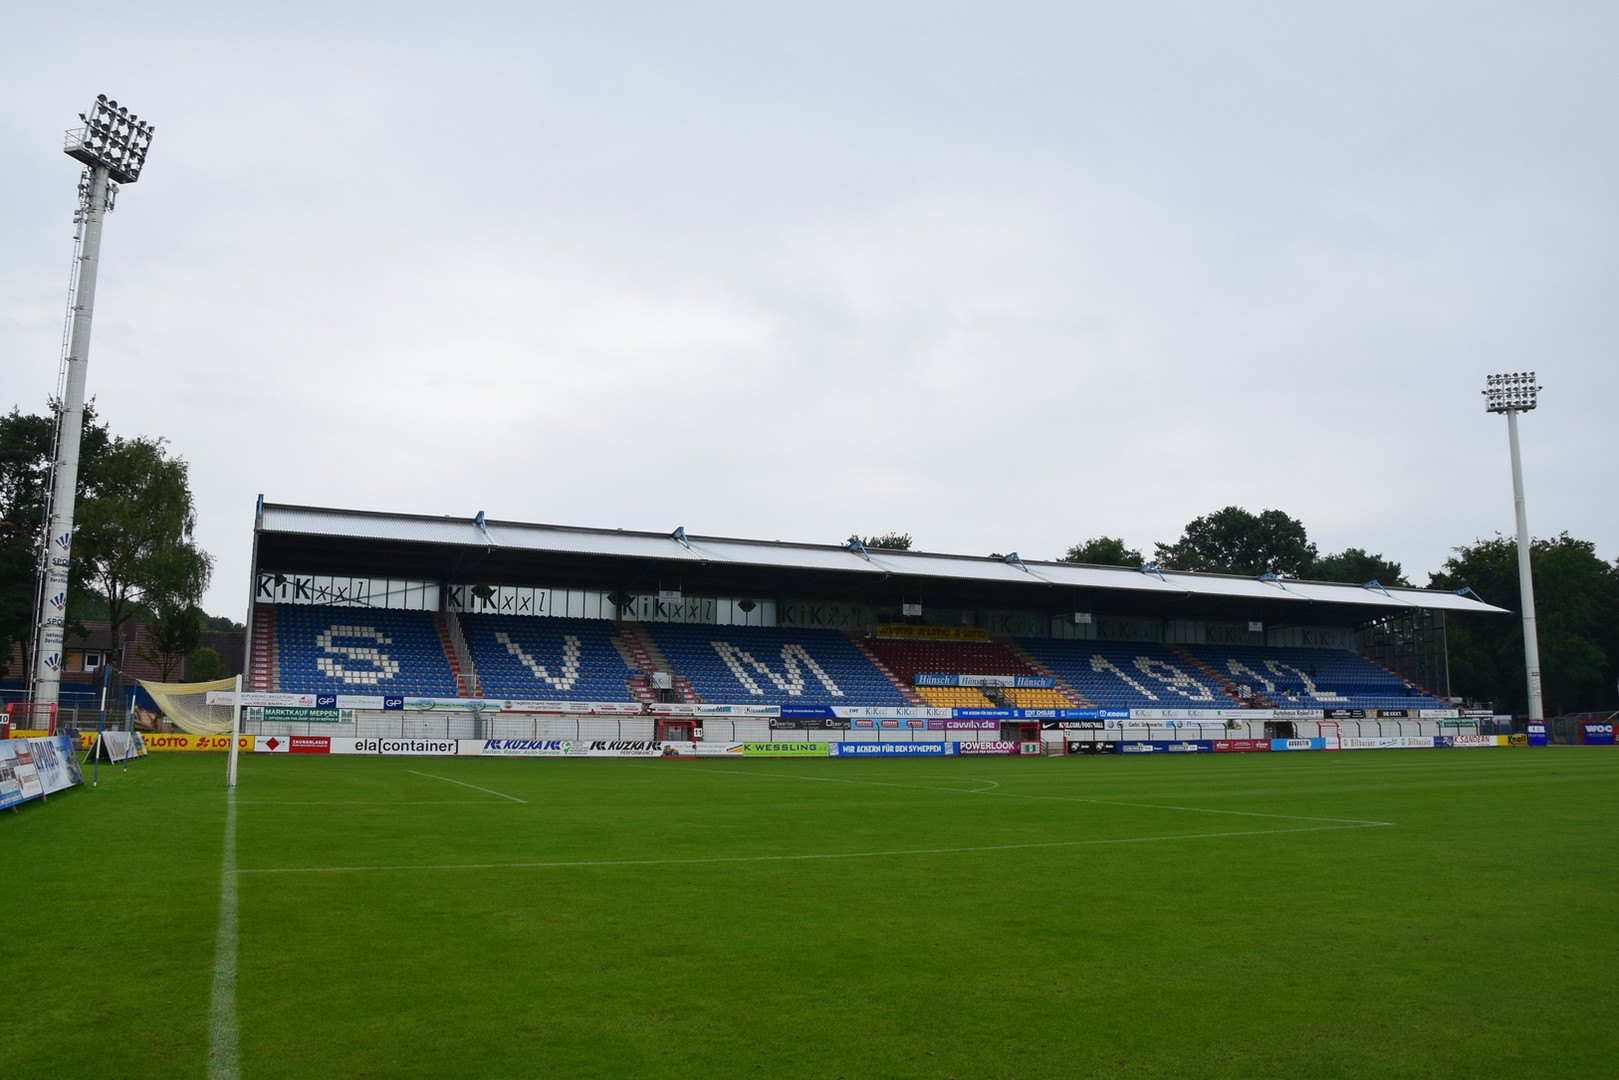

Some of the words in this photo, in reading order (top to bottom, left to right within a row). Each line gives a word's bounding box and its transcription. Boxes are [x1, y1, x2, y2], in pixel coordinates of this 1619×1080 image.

[918, 675, 949, 685] Hänsch
[1017, 677, 1047, 687] Hänsch
[151, 737, 188, 747] LOTTO
[503, 740, 543, 750] KUZKA
[608, 741, 647, 751] KUZKA
[960, 741, 1015, 750] POWERLOOK
[843, 745, 855, 753] WIR
[856, 745, 881, 753] ACKERN
[882, 744, 894, 753] FÜR
